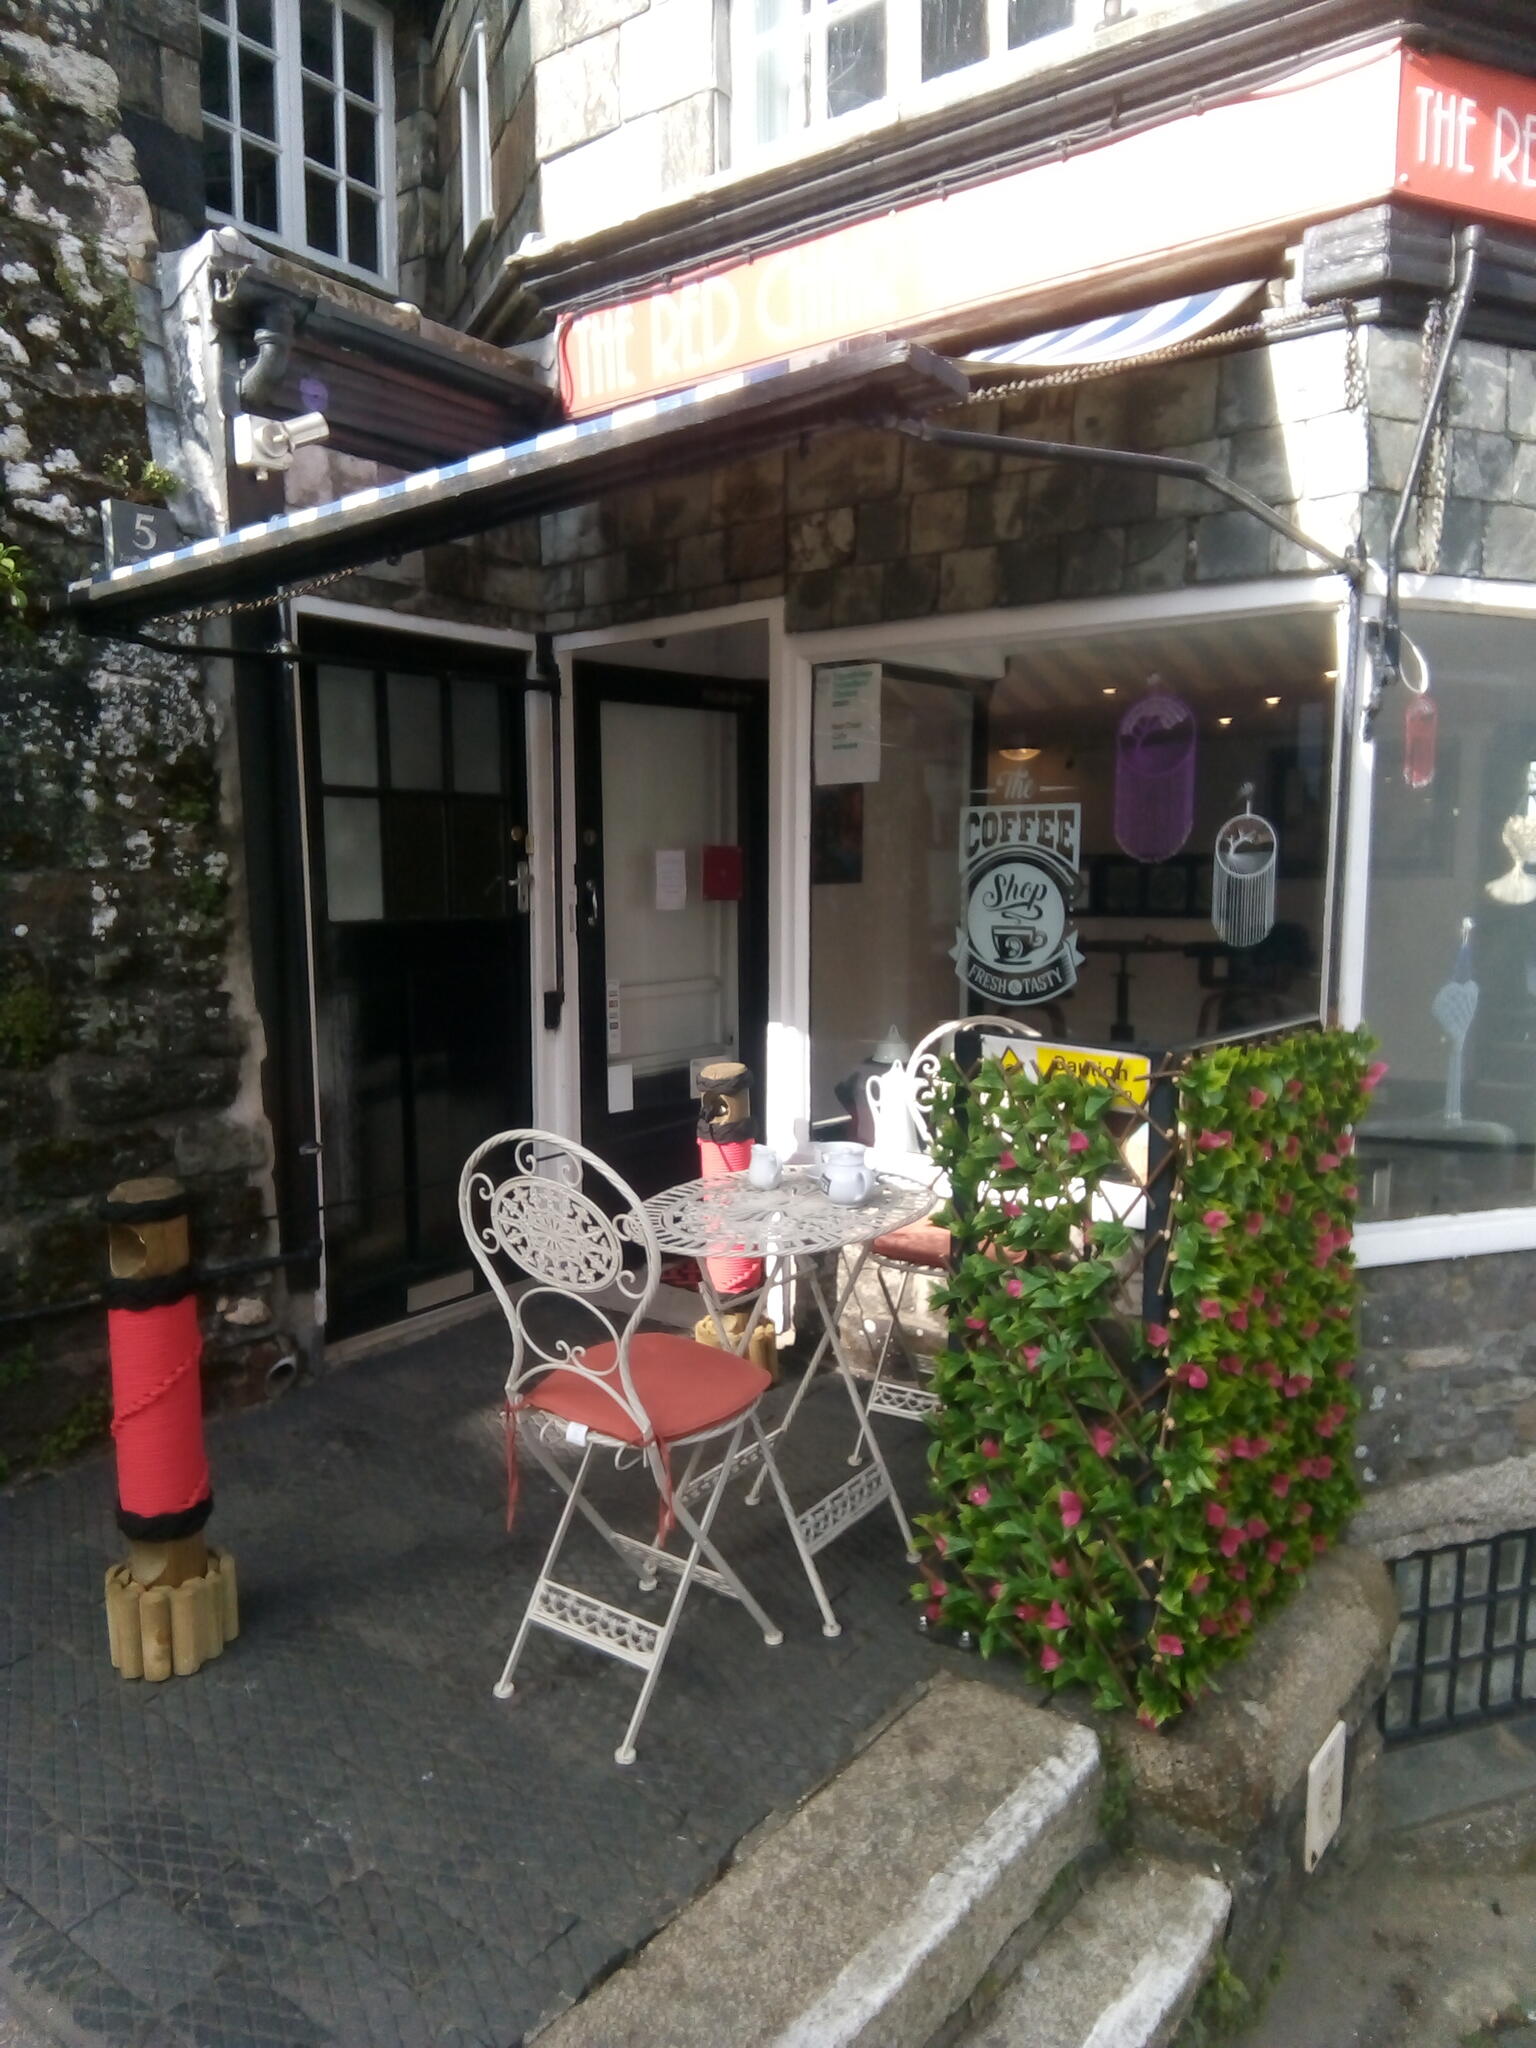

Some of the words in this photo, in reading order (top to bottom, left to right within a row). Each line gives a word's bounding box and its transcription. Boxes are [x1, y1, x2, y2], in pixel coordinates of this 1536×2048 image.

[1415, 85, 1477, 173] THE
[574, 303, 638, 399] THE
[649, 275, 741, 379] RED
[132, 513, 157, 550] 5
[996, 768, 1034, 799] The
[966, 809, 1075, 863] COFFEE
[982, 873, 1047, 913] Shop
[968, 964, 1006, 994] FRESH
[1022, 967, 1062, 994] TASTY
